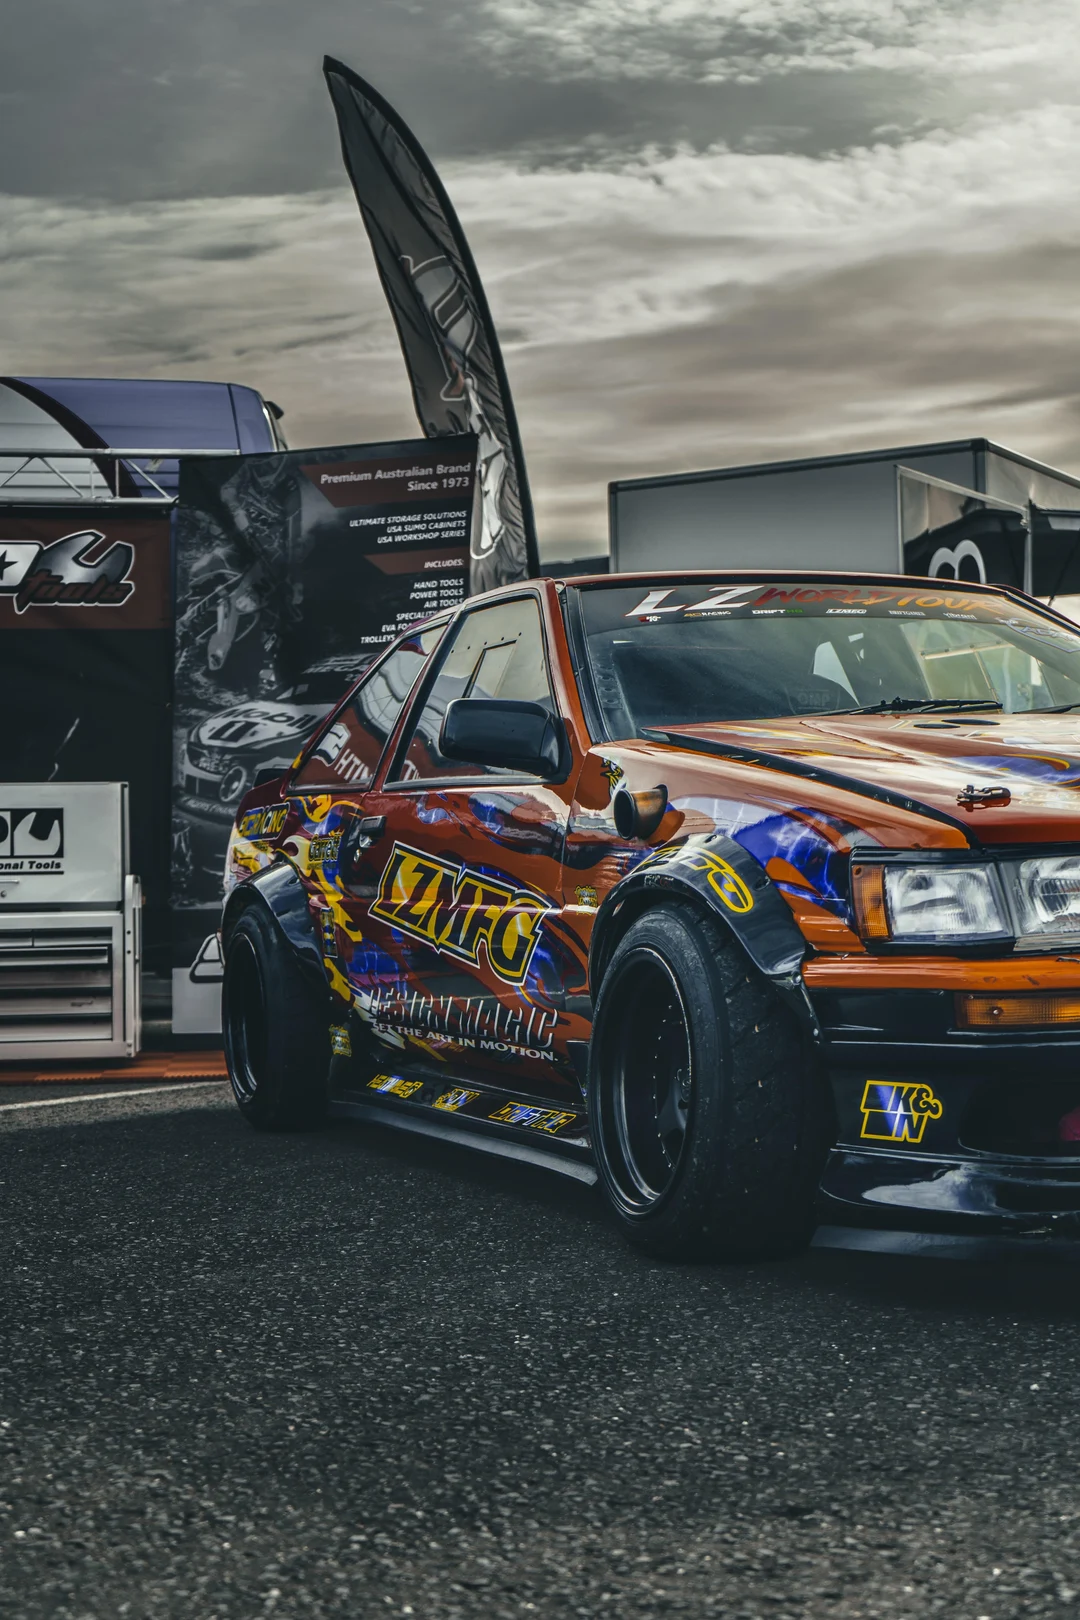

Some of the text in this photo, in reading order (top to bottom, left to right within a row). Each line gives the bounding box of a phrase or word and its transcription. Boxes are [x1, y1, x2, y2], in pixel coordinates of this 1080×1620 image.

[320, 462, 471, 484] Premium Australian Brand
[407, 476, 469, 491] Since 1973
[349, 510, 467, 527] ULTIMATE STORAGE SOLUTIONS
[387, 520, 466, 533] USA SUMO CABINETS
[377, 529, 466, 544] USA WORKSHOP SERIES
[424, 559, 464, 568] INCLUDES:
[413, 578, 464, 590] HAND TOOLS
[409, 588, 464, 600] POWER TOOLS
[623, 585, 766, 617] LZ
[423, 598, 464, 609] AIR TOOLS
[381, 624, 396, 633] EVA
[360, 634, 396, 644] TROLLEYS
[214, 707, 318, 730] Mobil
[28, 860, 62, 870] Tools
[369, 842, 551, 984] LZMFG
[458, 997, 559, 1048] MAGIC
[372, 1022, 559, 1062] SET THE ART IN MOTION.
